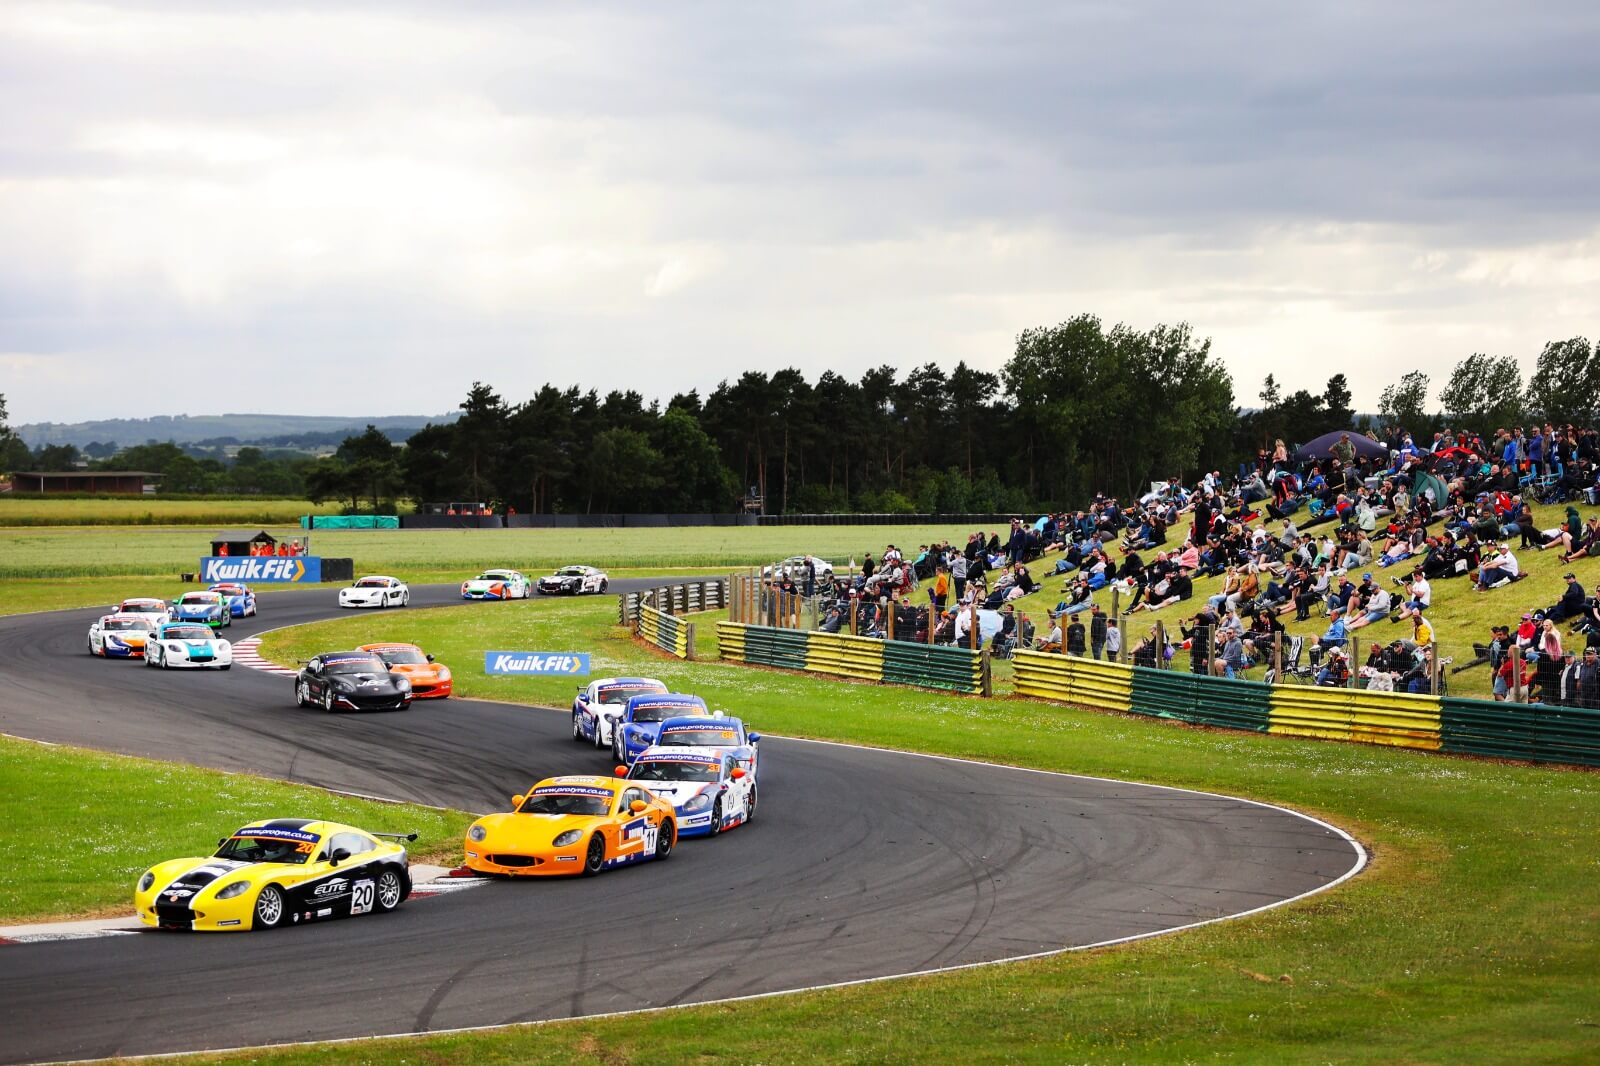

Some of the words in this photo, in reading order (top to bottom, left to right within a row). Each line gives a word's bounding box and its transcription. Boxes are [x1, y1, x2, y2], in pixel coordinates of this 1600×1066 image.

[206, 558, 264, 582] Kwik
[262, 558, 296, 580] Fit
[493, 654, 545, 672] Kwik
[543, 655, 572, 671] Fit
[667, 724, 733, 732] www.protyre.co.uk
[643, 754, 715, 763] www.protyre.co.uk
[535, 786, 610, 796] www.protyre.co.uk
[240, 829, 314, 841] www.protyre.co.uk
[646, 829, 655, 849] 11
[295, 842, 315, 854] 20
[313, 882, 349, 895] ELITE
[354, 884, 373, 908] 20
